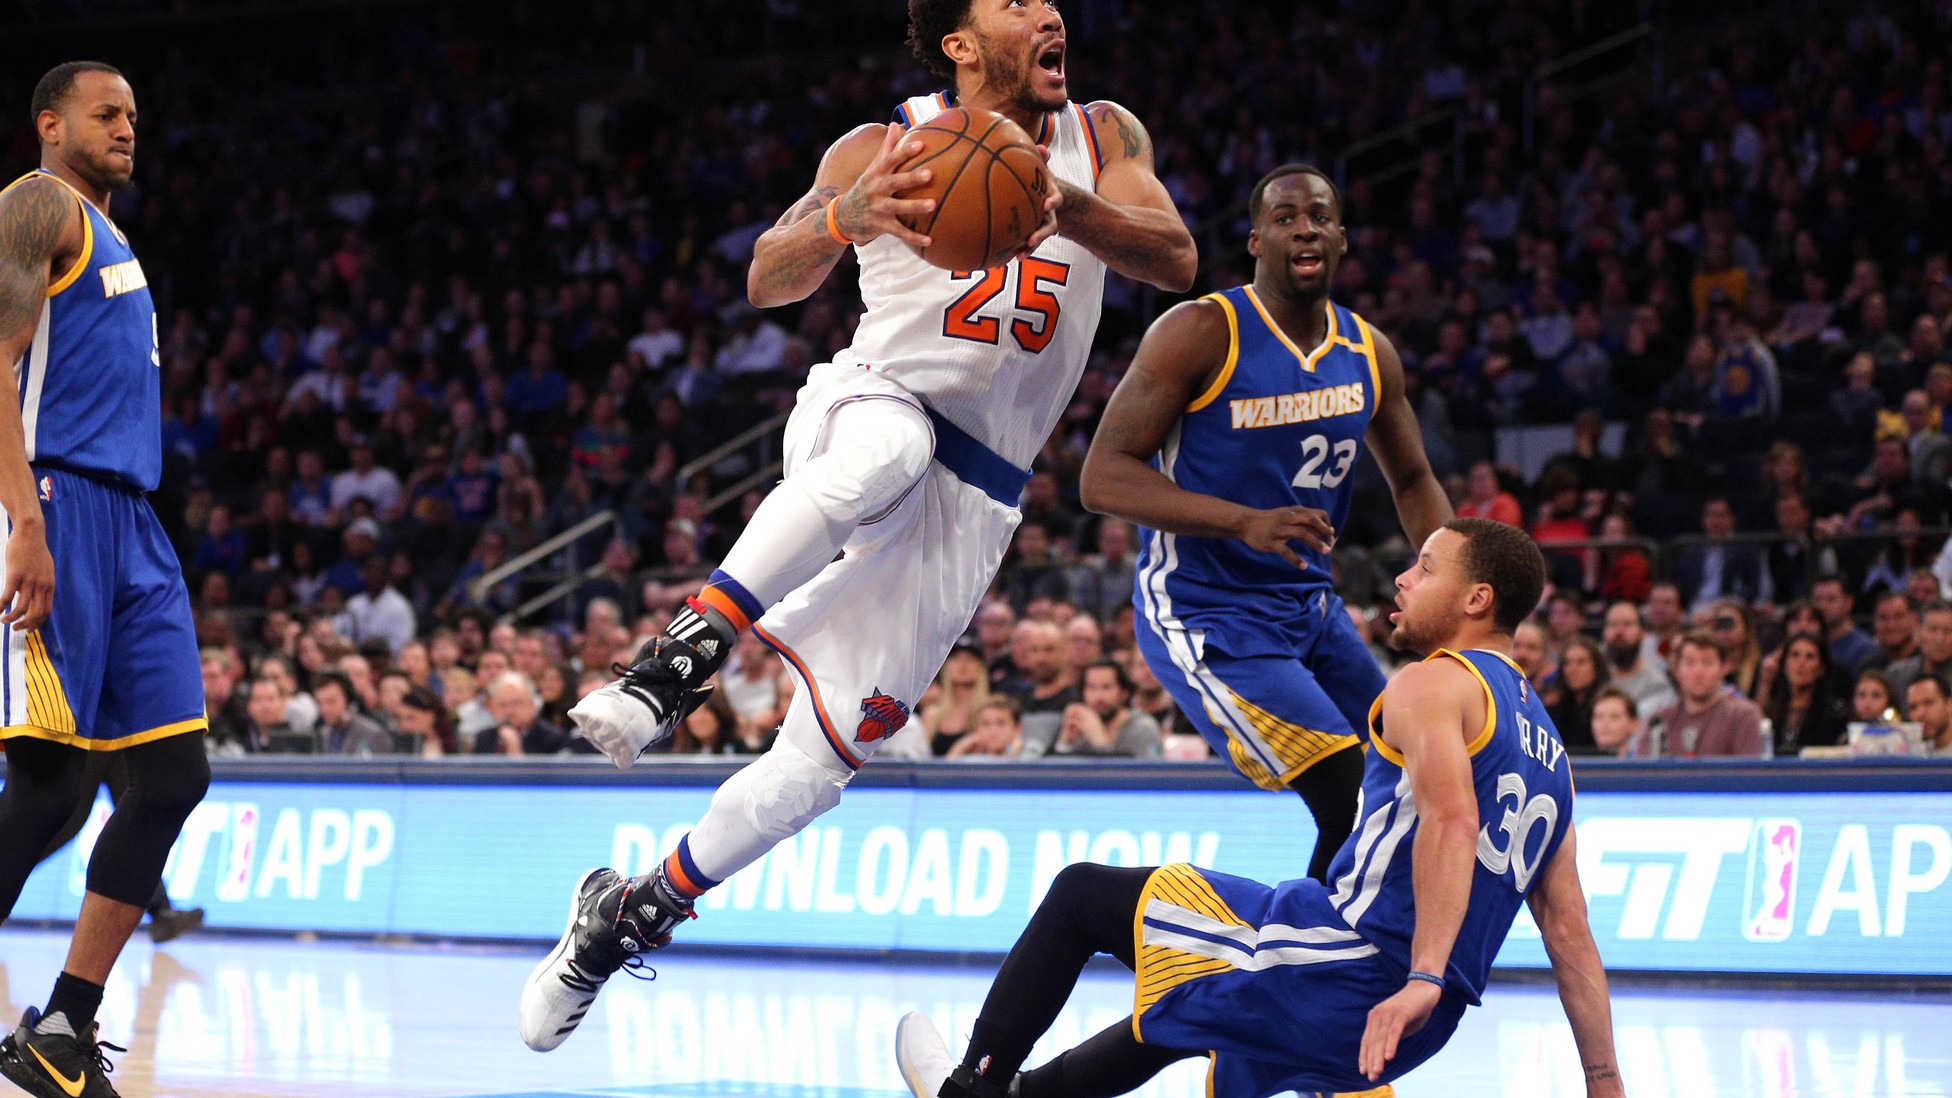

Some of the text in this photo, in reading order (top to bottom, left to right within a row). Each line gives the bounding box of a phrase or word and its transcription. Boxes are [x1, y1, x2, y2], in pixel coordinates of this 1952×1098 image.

[942, 255, 1071, 355] 25
[1229, 382, 1365, 430] WARRIORS
[1291, 434, 1357, 490] 23
[254, 807, 394, 900] APP
[1476, 773, 1558, 893] 30
